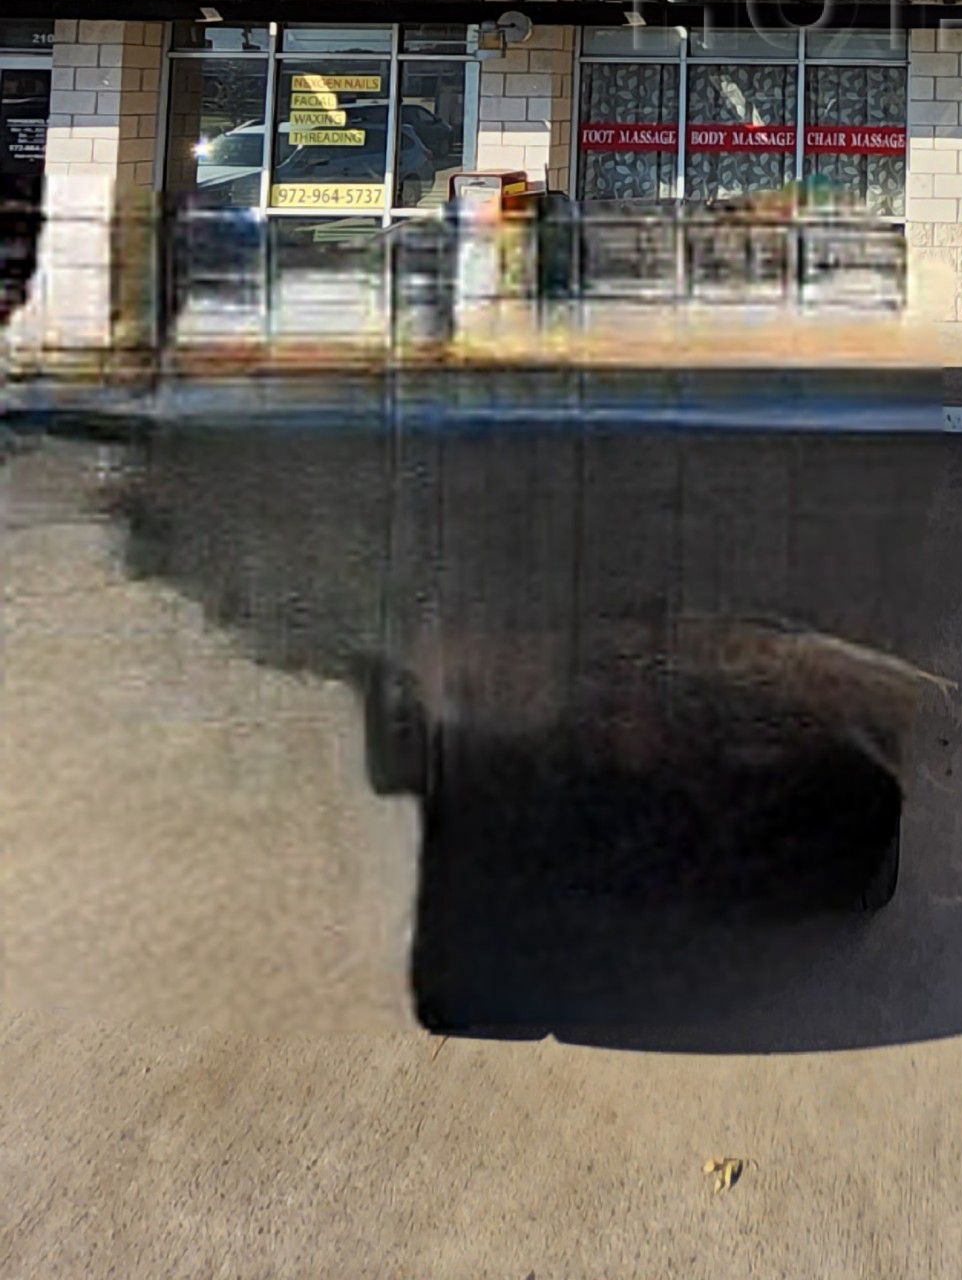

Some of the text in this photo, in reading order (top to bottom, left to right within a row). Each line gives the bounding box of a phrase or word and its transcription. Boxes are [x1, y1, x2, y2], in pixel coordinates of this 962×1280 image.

[31, 33, 54, 43] 210
[345, 78, 379, 89] NAILS
[294, 96, 334, 107] FACIAL
[294, 114, 343, 125] WAXING
[293, 132, 362, 144] THREADING
[582, 129, 676, 144] FOOT MASSAGE
[690, 131, 795, 146] BODY MASSAGE
[806, 132, 905, 149] CHAIR MASSAGE
[278, 188, 383, 204] 972-964-5737
